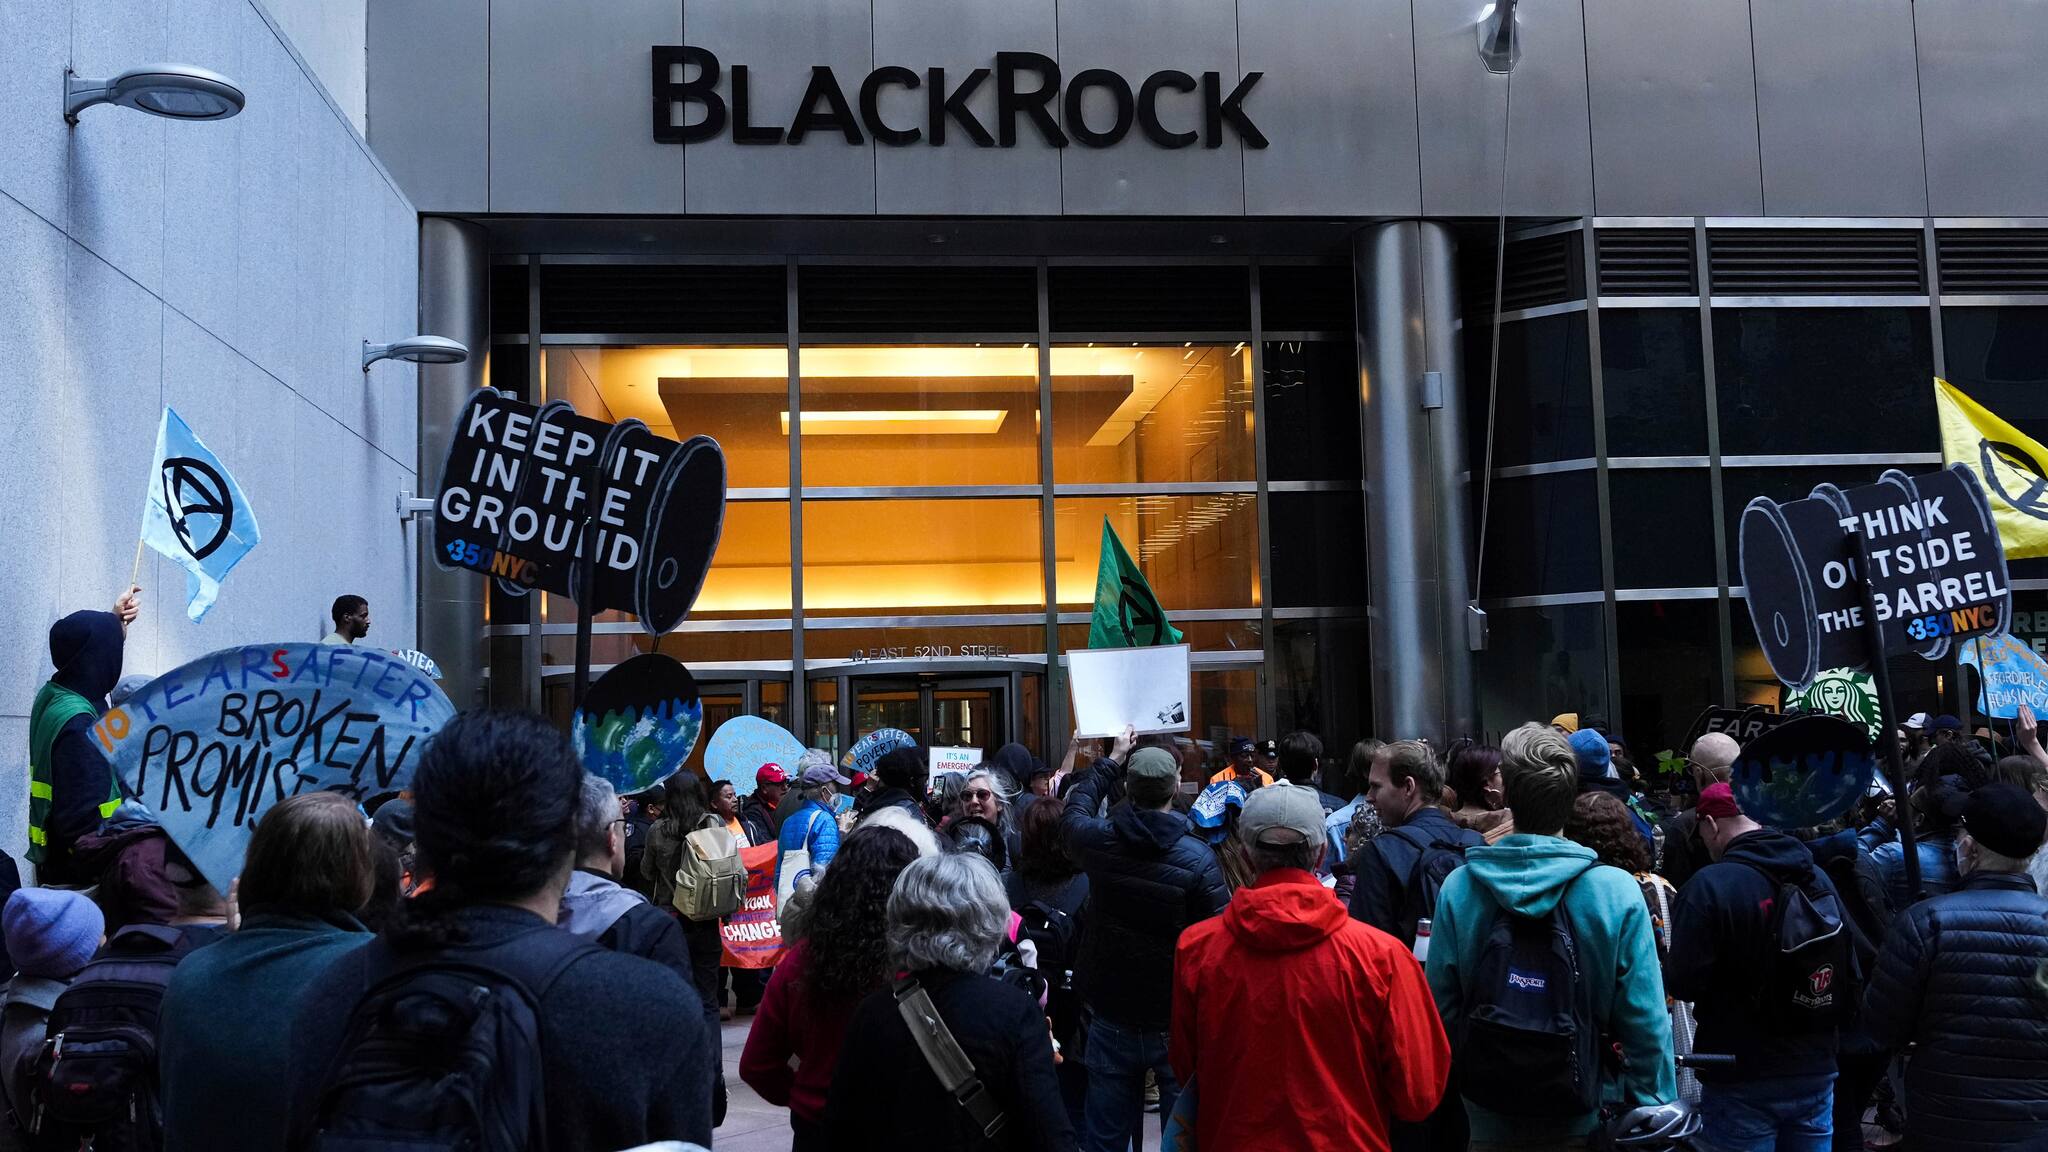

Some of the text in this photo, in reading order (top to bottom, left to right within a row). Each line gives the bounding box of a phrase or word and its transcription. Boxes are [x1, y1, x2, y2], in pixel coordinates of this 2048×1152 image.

[467, 403, 660, 487] KEEP IT
[470, 448, 632, 527] IN THE
[1838, 496, 1949, 540] THINK
[1817, 570, 2008, 634] THE BARREL
[1906, 604, 1996, 642] 350NYC
[868, 646, 908, 661] EAST
[913, 645, 952, 658] 52ND
[95, 707, 130, 754] 10
[216, 688, 416, 791] BROKEN
[849, 733, 878, 757] YEARS
[856, 738, 900, 769] POVERTY
[959, 753, 969, 761] AN
[744, 894, 774, 912] YORK
[723, 919, 782, 942] CHANGE
